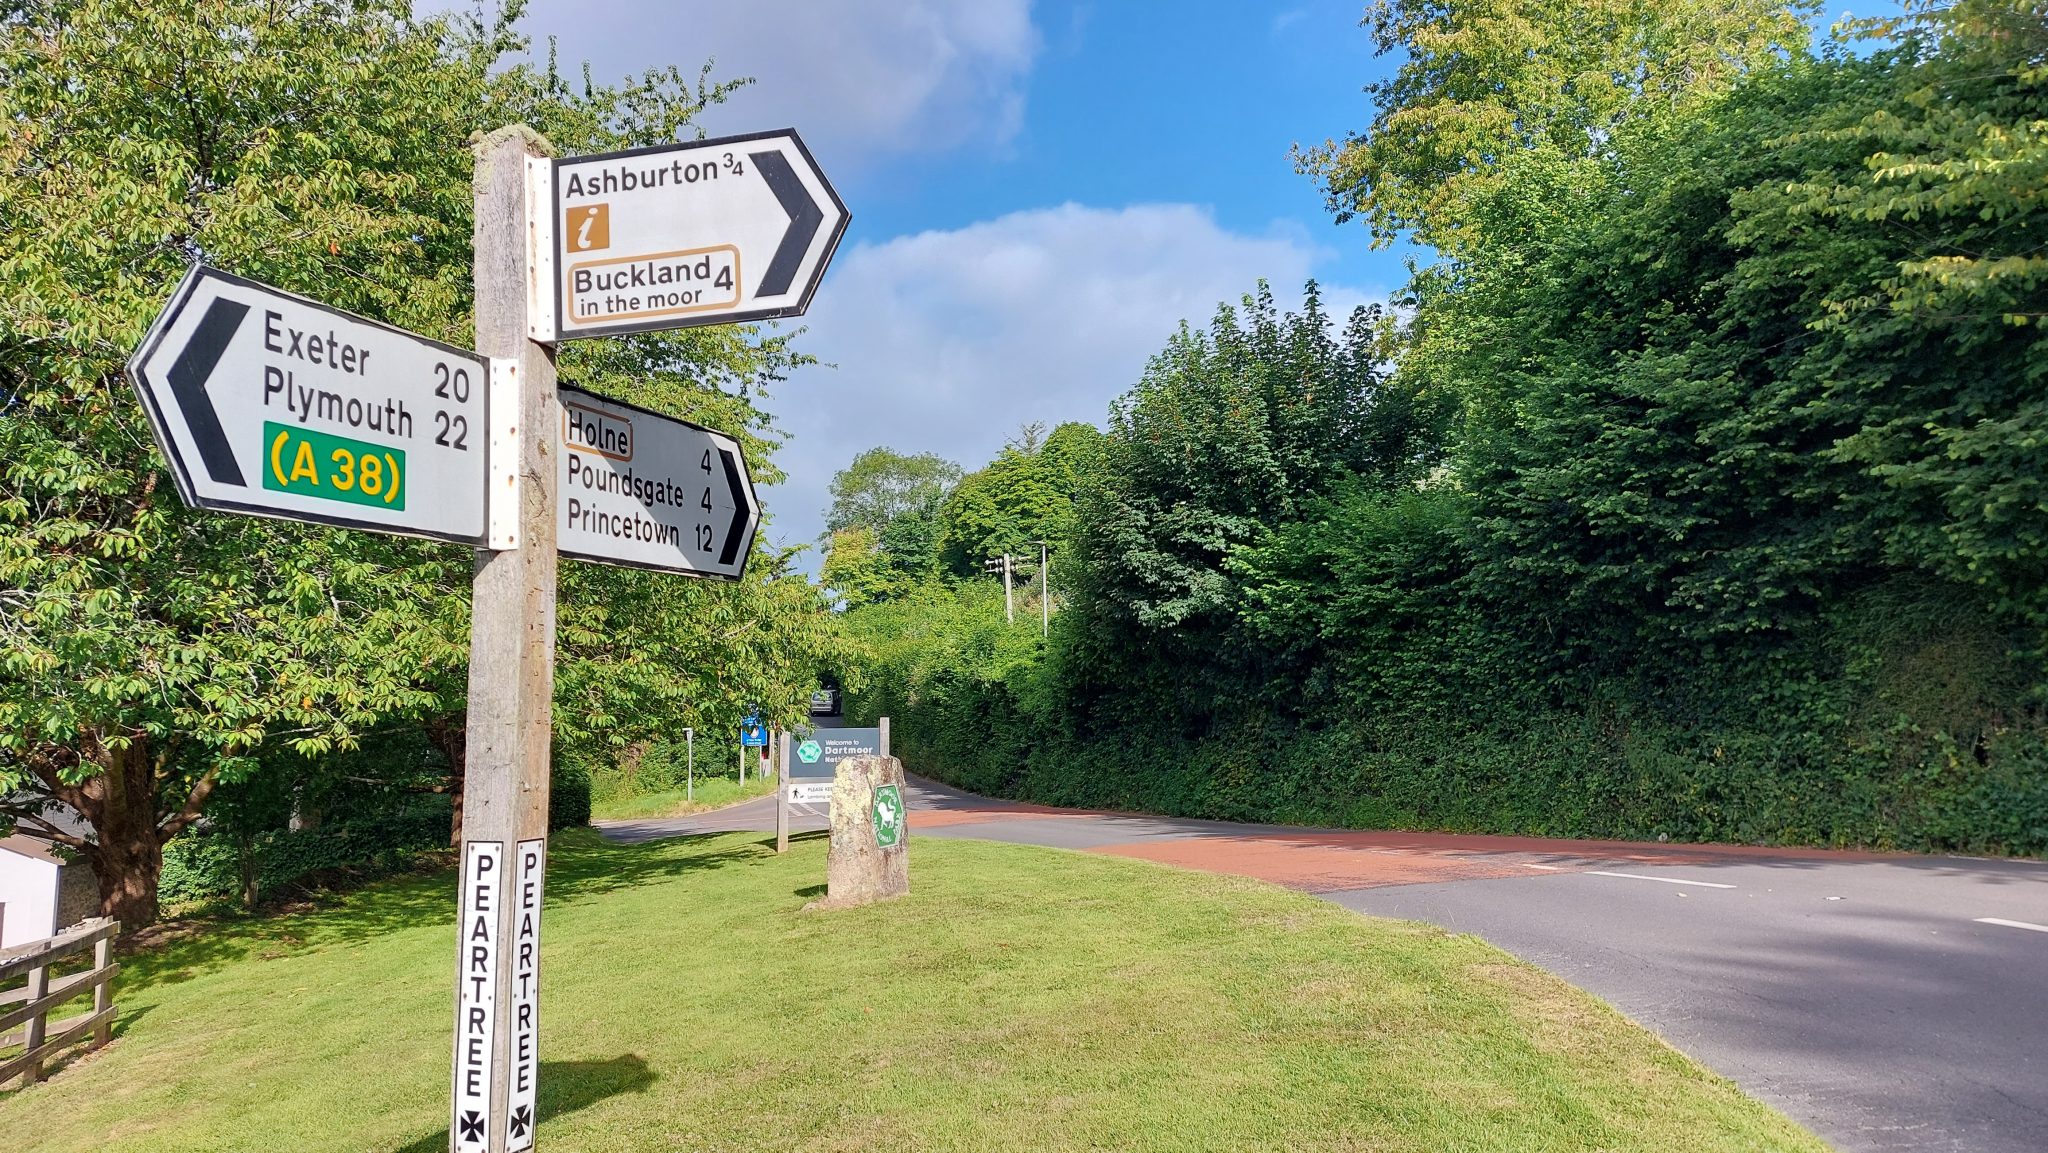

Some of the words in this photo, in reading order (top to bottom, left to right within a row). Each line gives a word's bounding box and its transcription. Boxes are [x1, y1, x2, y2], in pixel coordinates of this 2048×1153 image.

[566, 160, 718, 198] Ashburton
[575, 256, 711, 294] Buckland
[713, 265, 734, 291] 4
[580, 298, 598, 316] in
[605, 294, 640, 313] the
[647, 289, 702, 309] moor
[264, 309, 370, 376] Exeter
[434, 362, 469, 403] 20
[263, 365, 412, 438] Plymouth
[434, 410, 468, 451] 22
[569, 409, 628, 454] Holne
[701, 449, 712, 475] 4
[568, 454, 683, 507] Poundsgate
[701, 487, 712, 514] 4
[568, 498, 679, 547] Princetown
[696, 523, 712, 552] 12
[825, 746, 873, 755] Dartmoor
[466, 854, 494, 1097] PEARTREE
[517, 853, 537, 1093] PEARTREE
